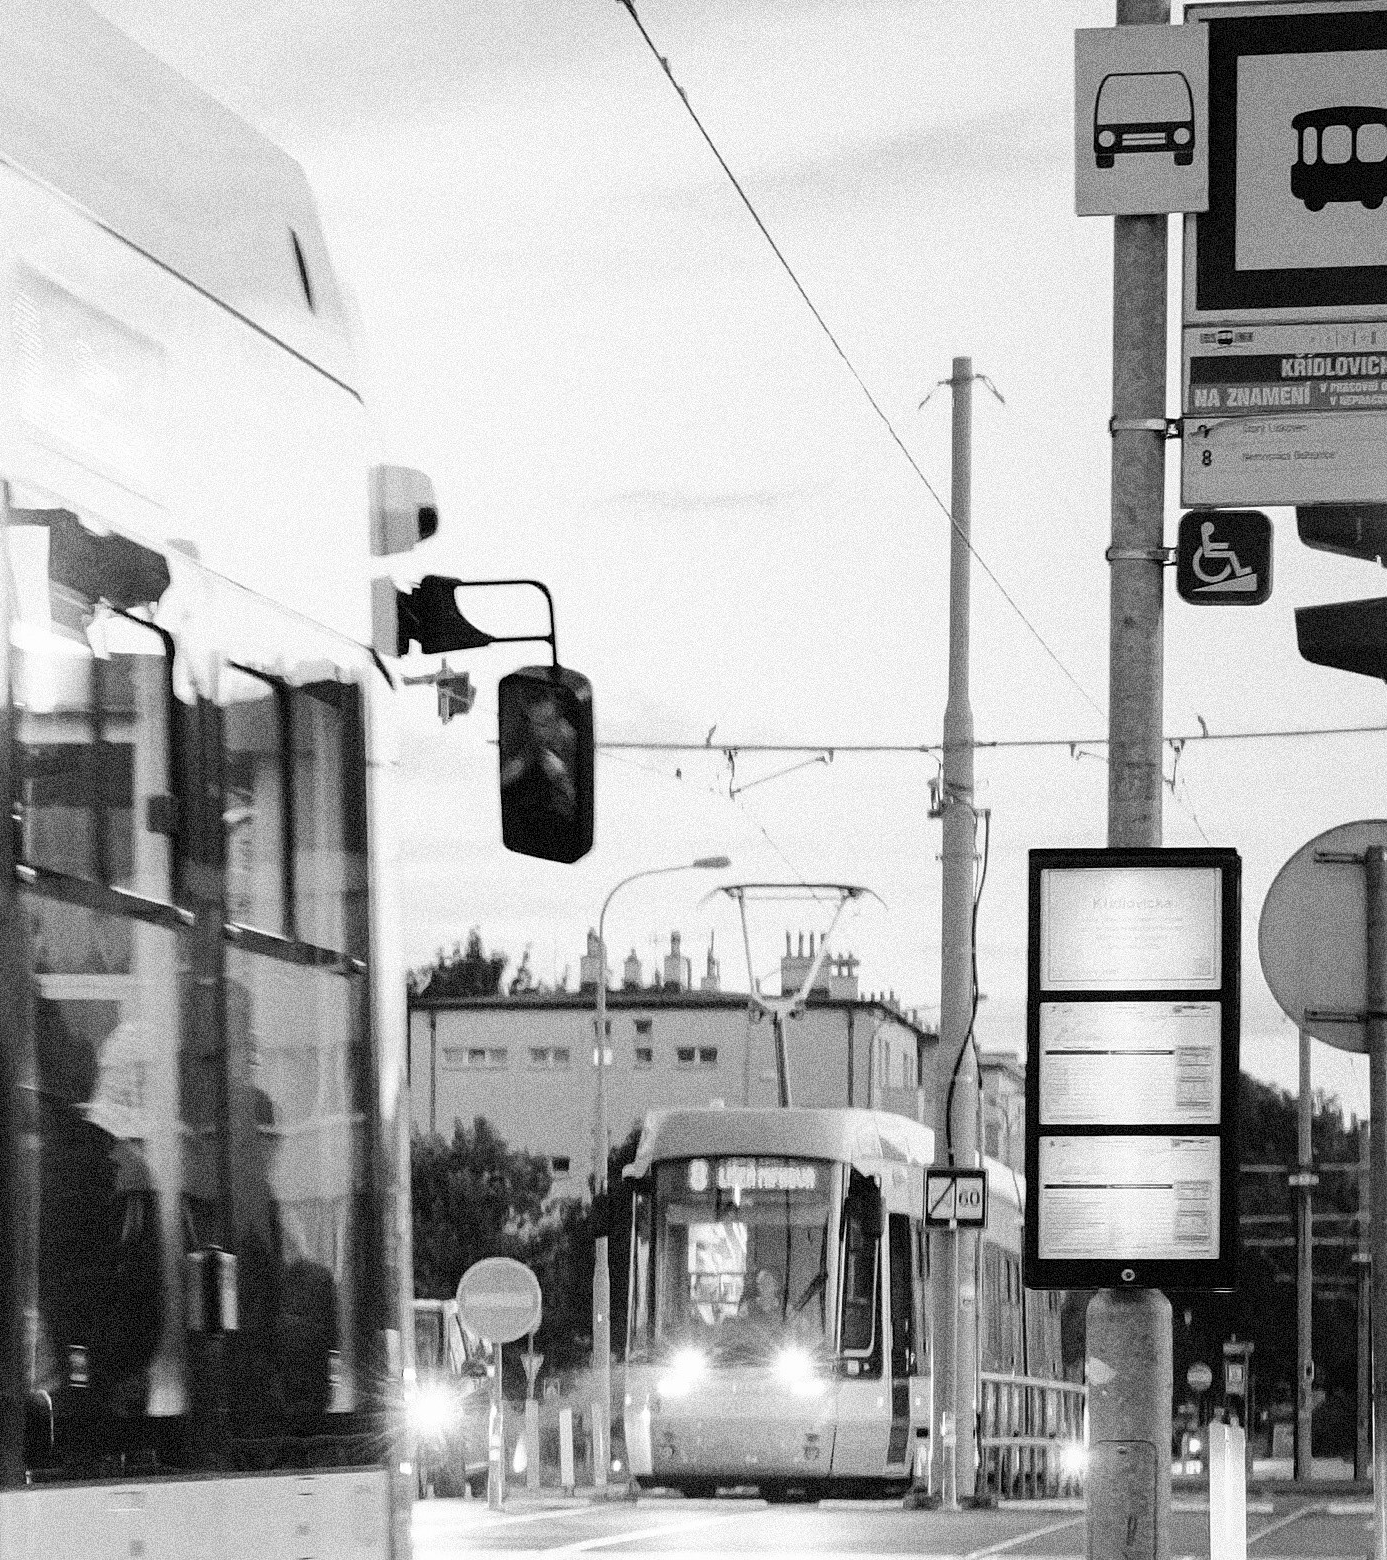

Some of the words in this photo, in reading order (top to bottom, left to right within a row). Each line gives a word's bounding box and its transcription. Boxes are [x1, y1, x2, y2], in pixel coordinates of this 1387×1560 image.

[1194, 388, 1221, 407] NA
[1226, 381, 1310, 407] ZNAMENÍ
[1201, 449, 1212, 467] 8
